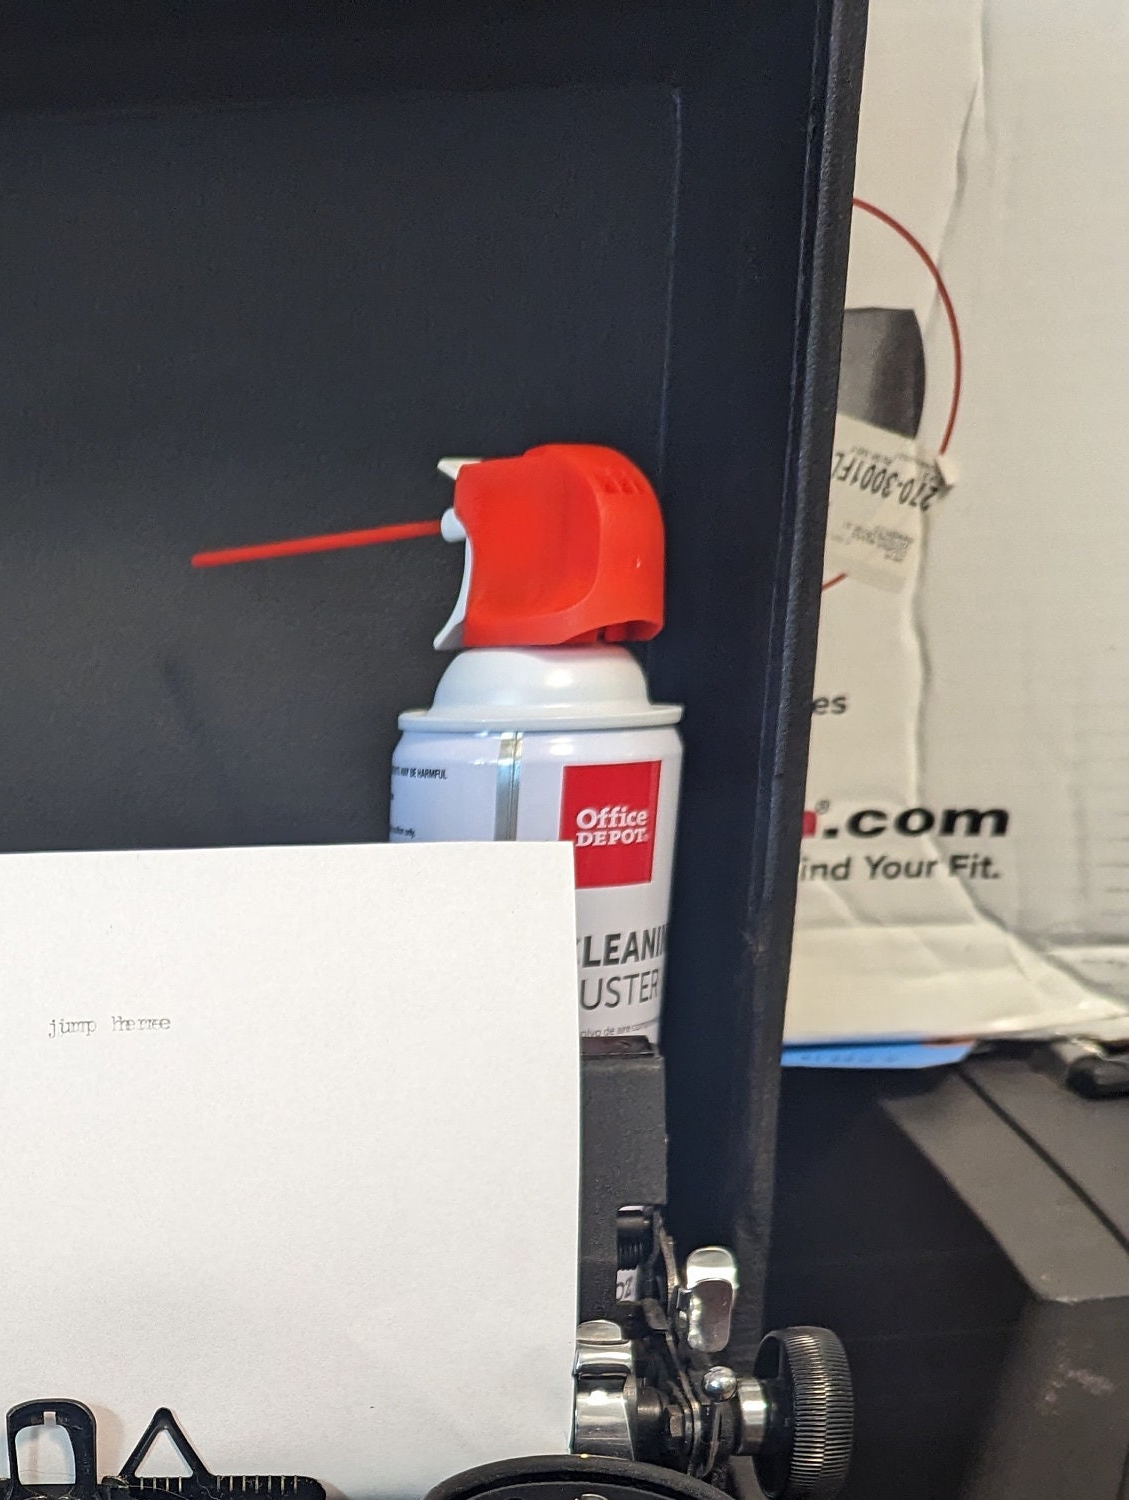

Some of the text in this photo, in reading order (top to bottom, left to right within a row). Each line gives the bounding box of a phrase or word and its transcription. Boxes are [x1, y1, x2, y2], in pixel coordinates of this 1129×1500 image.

[576, 806, 649, 830] Office
[865, 855, 939, 880] Your
[949, 853, 1003, 880] Fit.
[48, 1018, 97, 1039] jump
